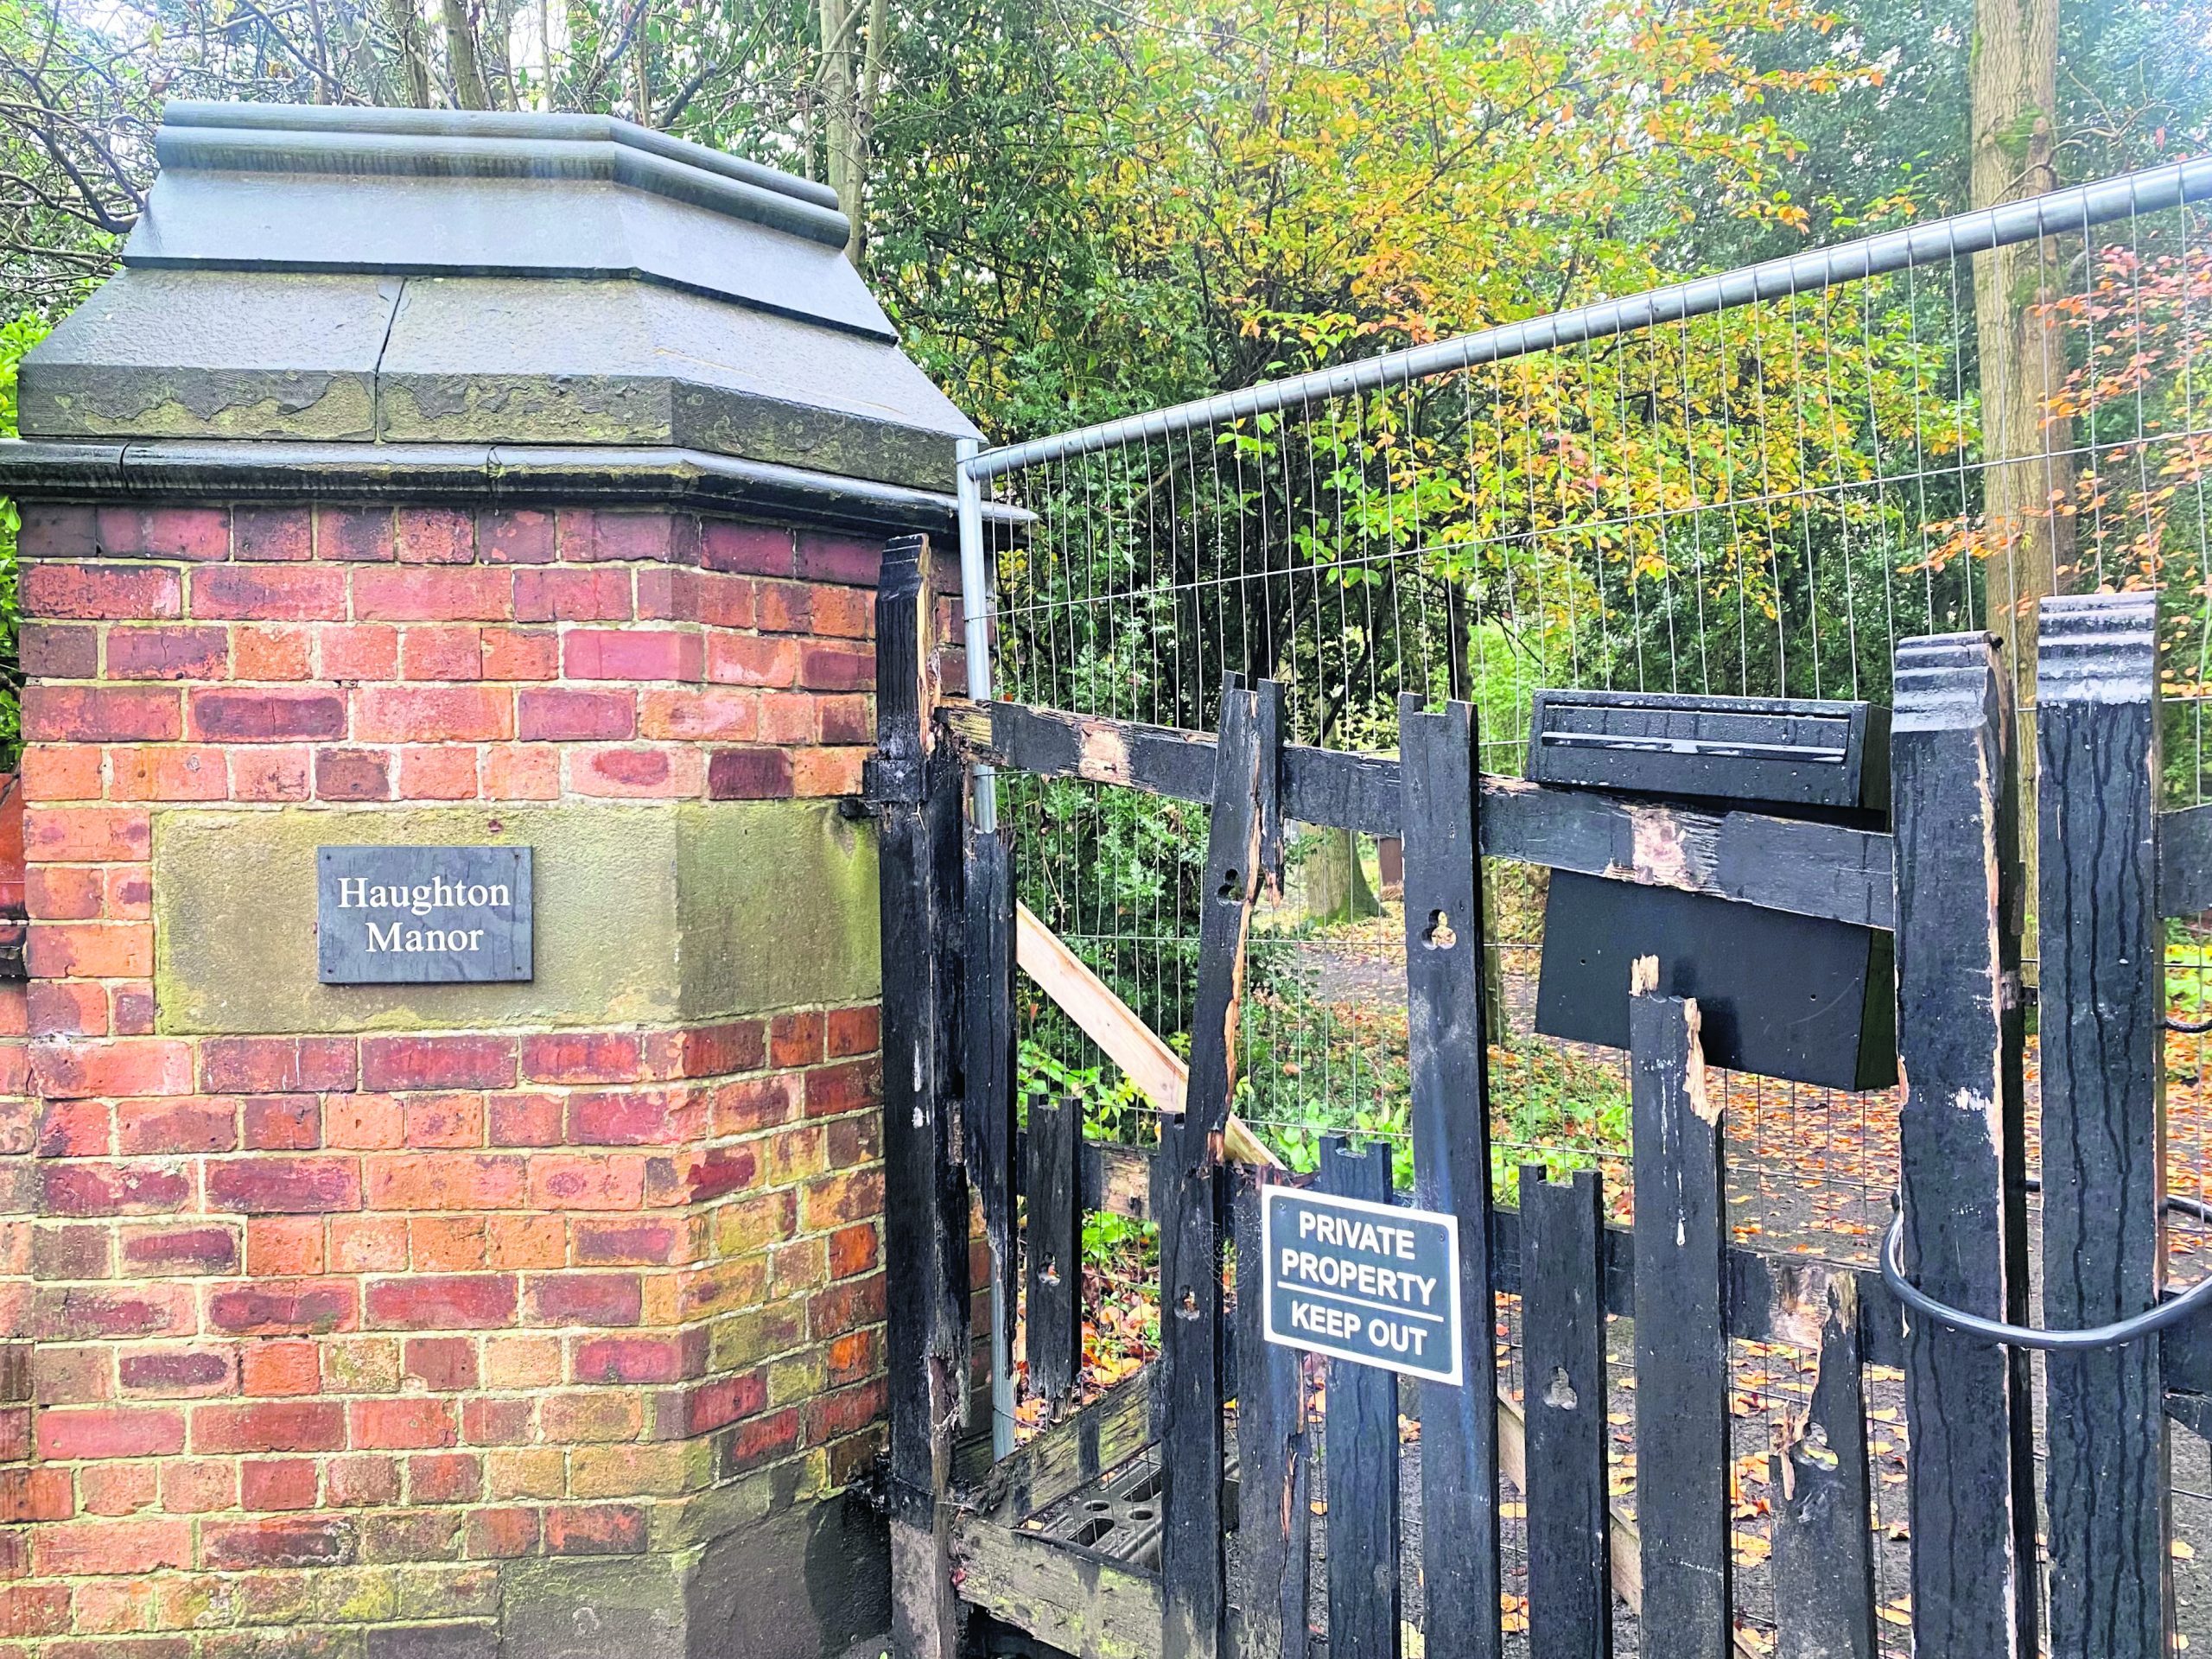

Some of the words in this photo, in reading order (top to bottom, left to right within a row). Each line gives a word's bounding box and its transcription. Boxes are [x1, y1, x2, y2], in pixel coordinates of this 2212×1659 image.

[337, 875, 511, 916] Haughton
[365, 921, 484, 952] Manor
[1299, 1211, 1415, 1260] PRIVATE
[1281, 1248, 1437, 1306] PROPERTY
[1291, 1300, 1361, 1339] KEEP
[1368, 1319, 1427, 1355] OUT
